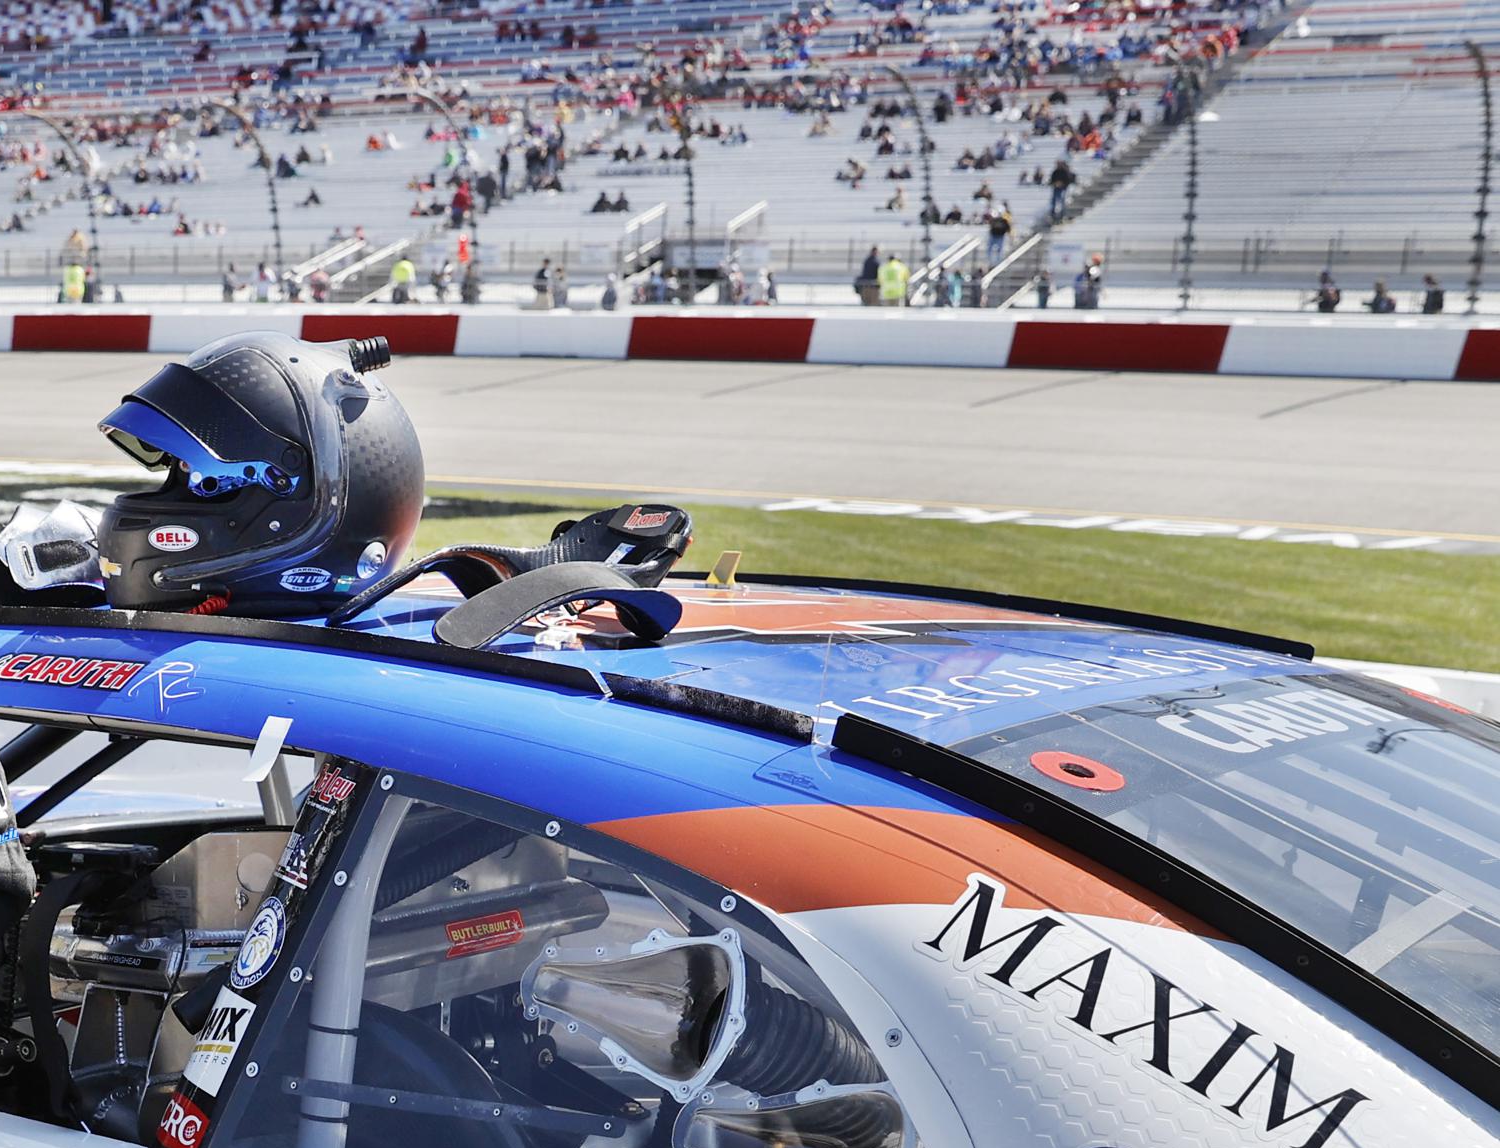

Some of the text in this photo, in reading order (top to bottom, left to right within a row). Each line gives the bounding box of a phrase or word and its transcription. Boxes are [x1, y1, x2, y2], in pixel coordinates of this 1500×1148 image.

[155, 532, 192, 544] BELL
[1155, 688, 1409, 754] CARUTH
[160, 1099, 202, 1146] CRC
